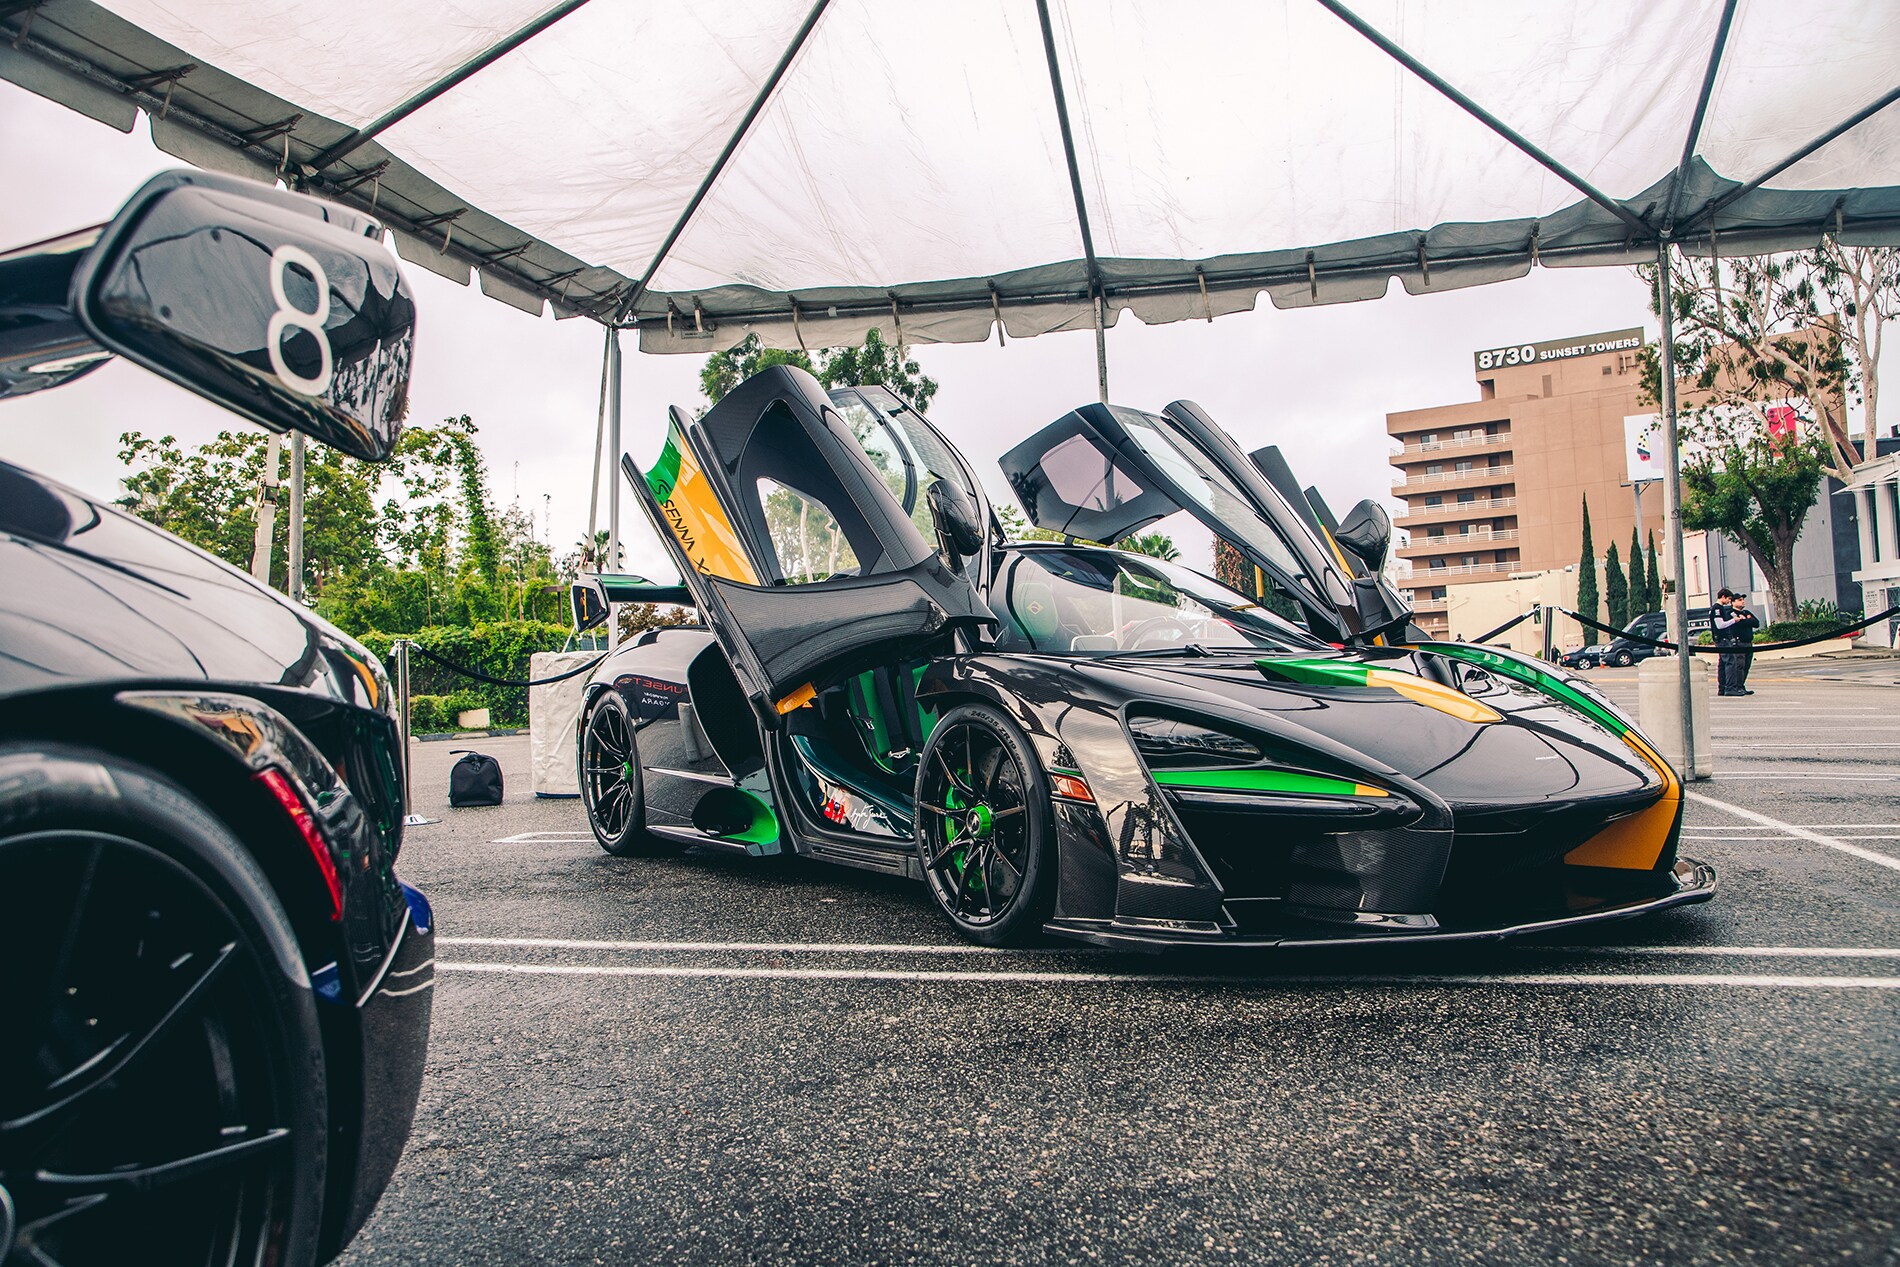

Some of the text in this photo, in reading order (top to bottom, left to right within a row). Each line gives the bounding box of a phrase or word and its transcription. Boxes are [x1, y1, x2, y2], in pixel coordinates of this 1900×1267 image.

[267, 244, 333, 396] 8
[1478, 337, 1640, 369] 8730 SUNSET TOWERS
[660, 499, 695, 551] SENNA
[971, 711, 999, 726] 245/35
[999, 727, 1016, 749] ZR19
